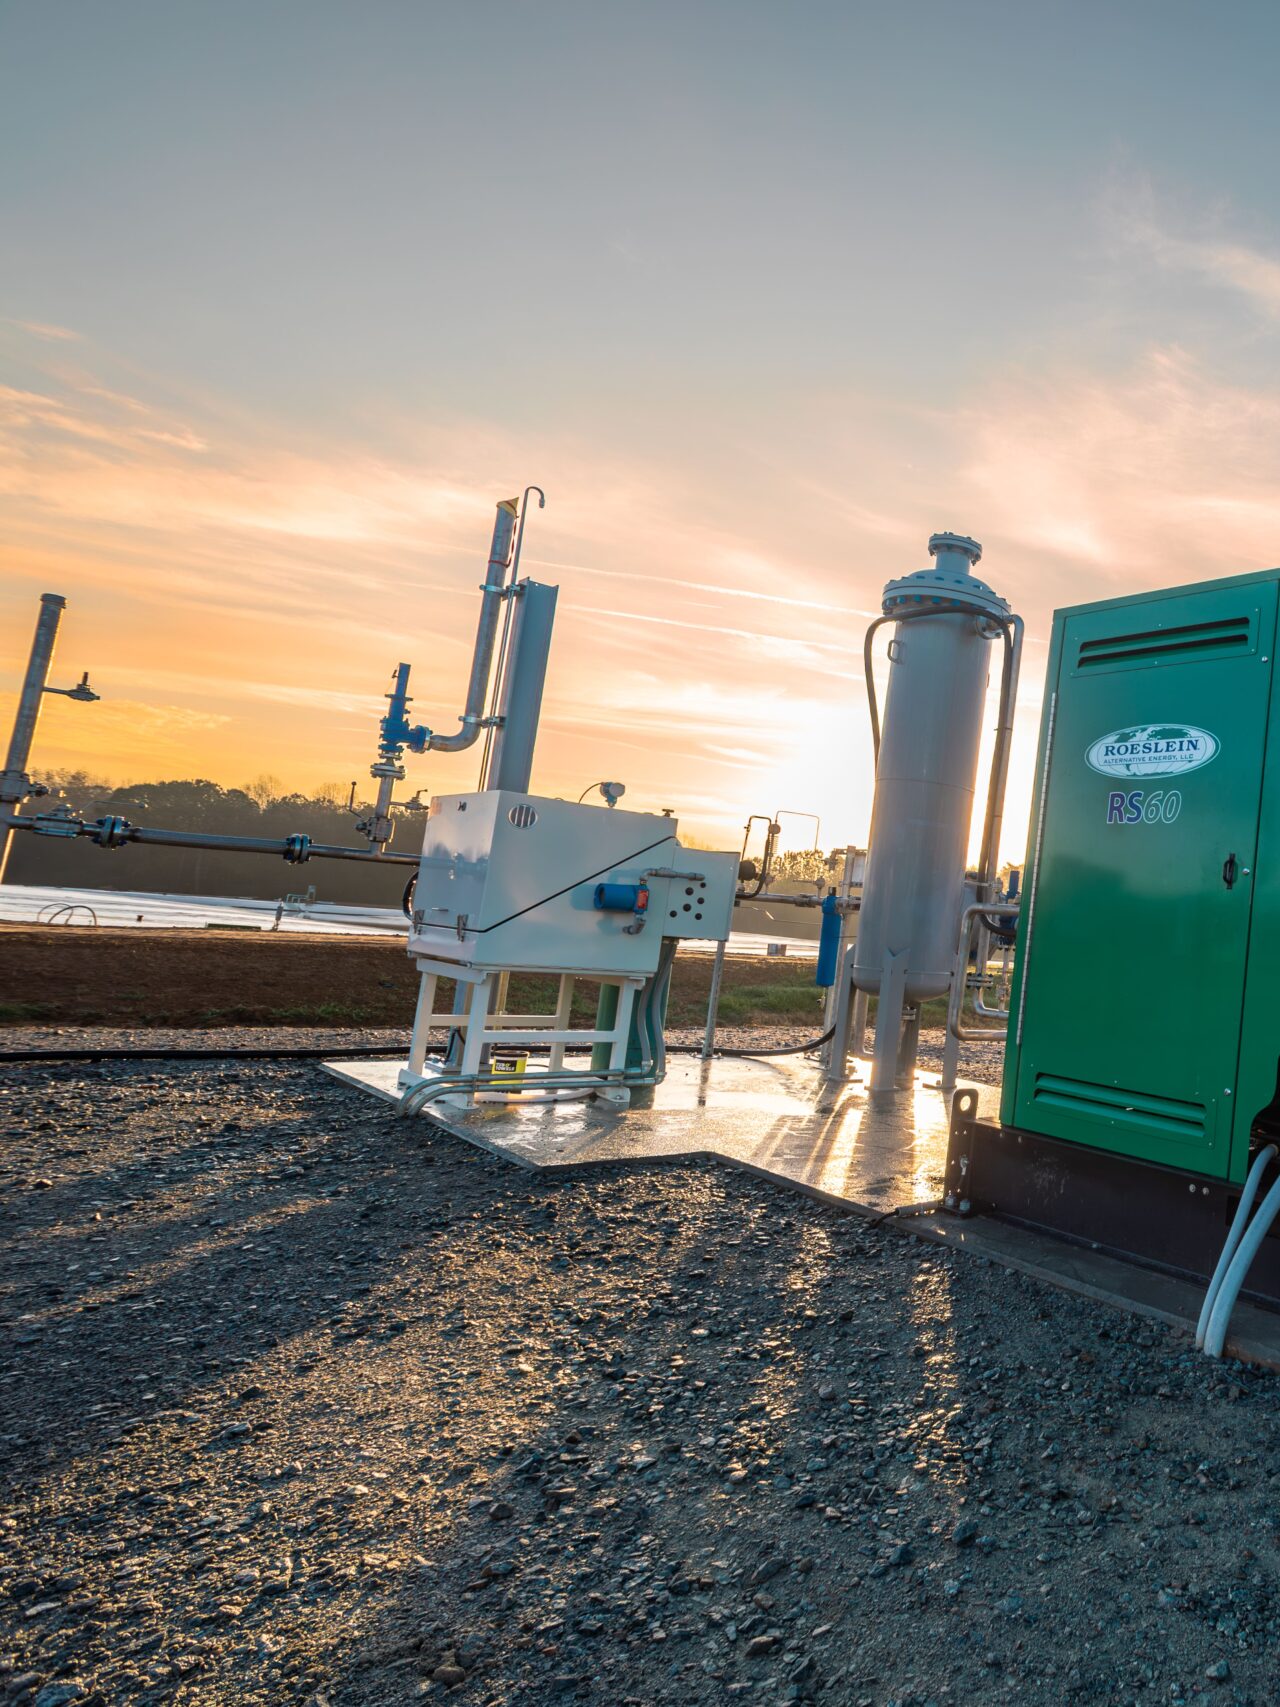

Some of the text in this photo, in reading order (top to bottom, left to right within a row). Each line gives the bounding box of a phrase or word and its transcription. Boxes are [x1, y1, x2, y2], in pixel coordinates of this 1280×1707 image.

[1104, 740, 1198, 756] ROESLEIN
[1103, 755, 1146, 764] ALTERNATIVE
[1107, 790, 1182, 824] RS60
